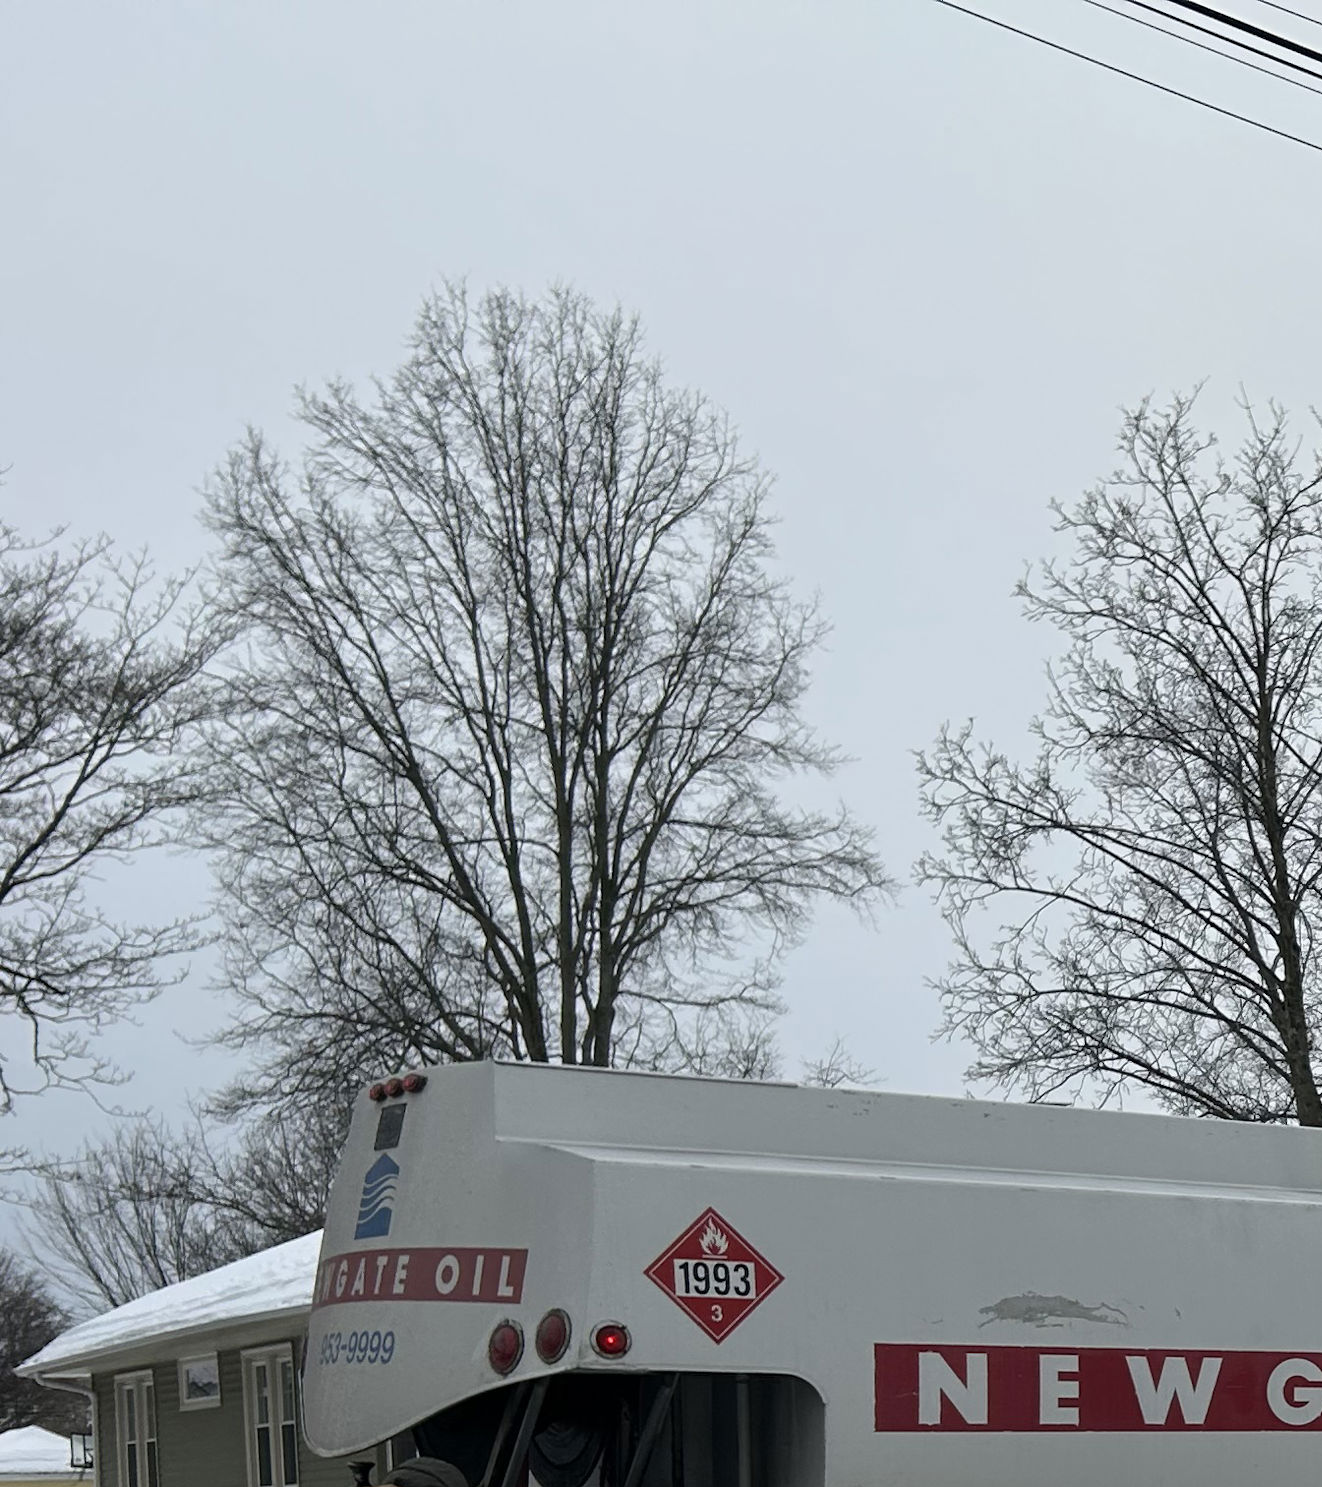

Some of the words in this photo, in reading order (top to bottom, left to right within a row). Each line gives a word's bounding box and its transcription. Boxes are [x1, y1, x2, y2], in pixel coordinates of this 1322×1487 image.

[434, 1254, 514, 1298] OIL
[678, 1261, 751, 1297] 1993
[711, 1304, 724, 1322] 3
[319, 1330, 396, 1366] 953-9999
